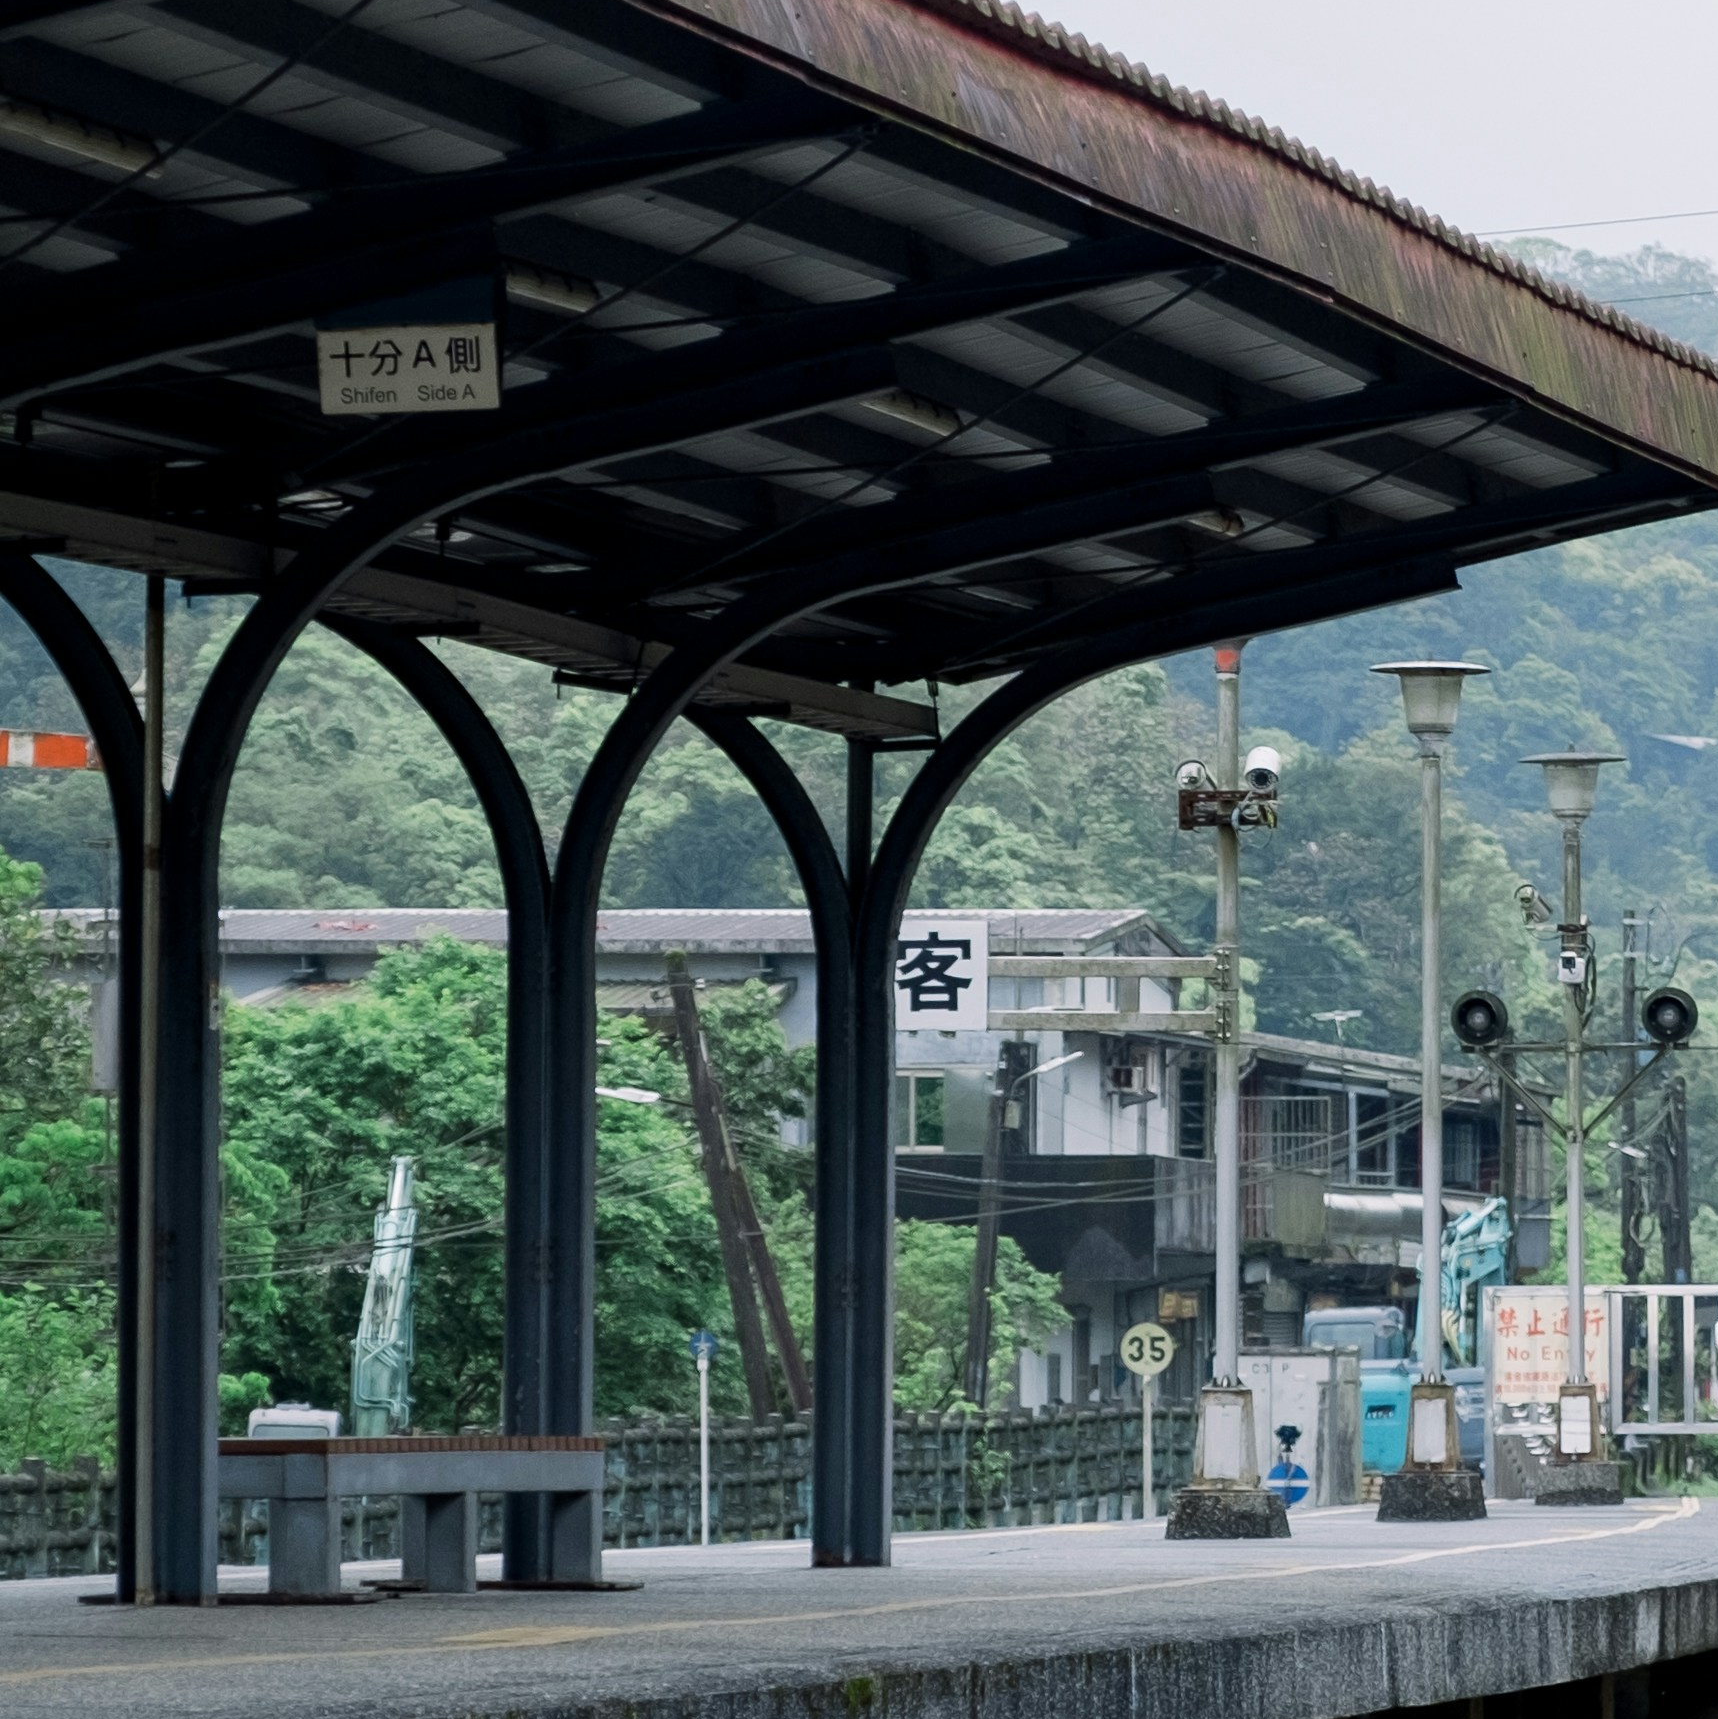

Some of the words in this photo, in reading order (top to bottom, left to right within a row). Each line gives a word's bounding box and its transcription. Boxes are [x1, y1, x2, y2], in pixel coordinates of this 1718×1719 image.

[340, 387, 398, 405] Shifen
[417, 384, 457, 402] Side
[462, 383, 476, 401] A
[895, 931, 973, 1012] 客
[1128, 1336, 1166, 1363] 35
[1506, 1346, 1531, 1362] No
[1541, 1345, 1596, 1363] Eny
